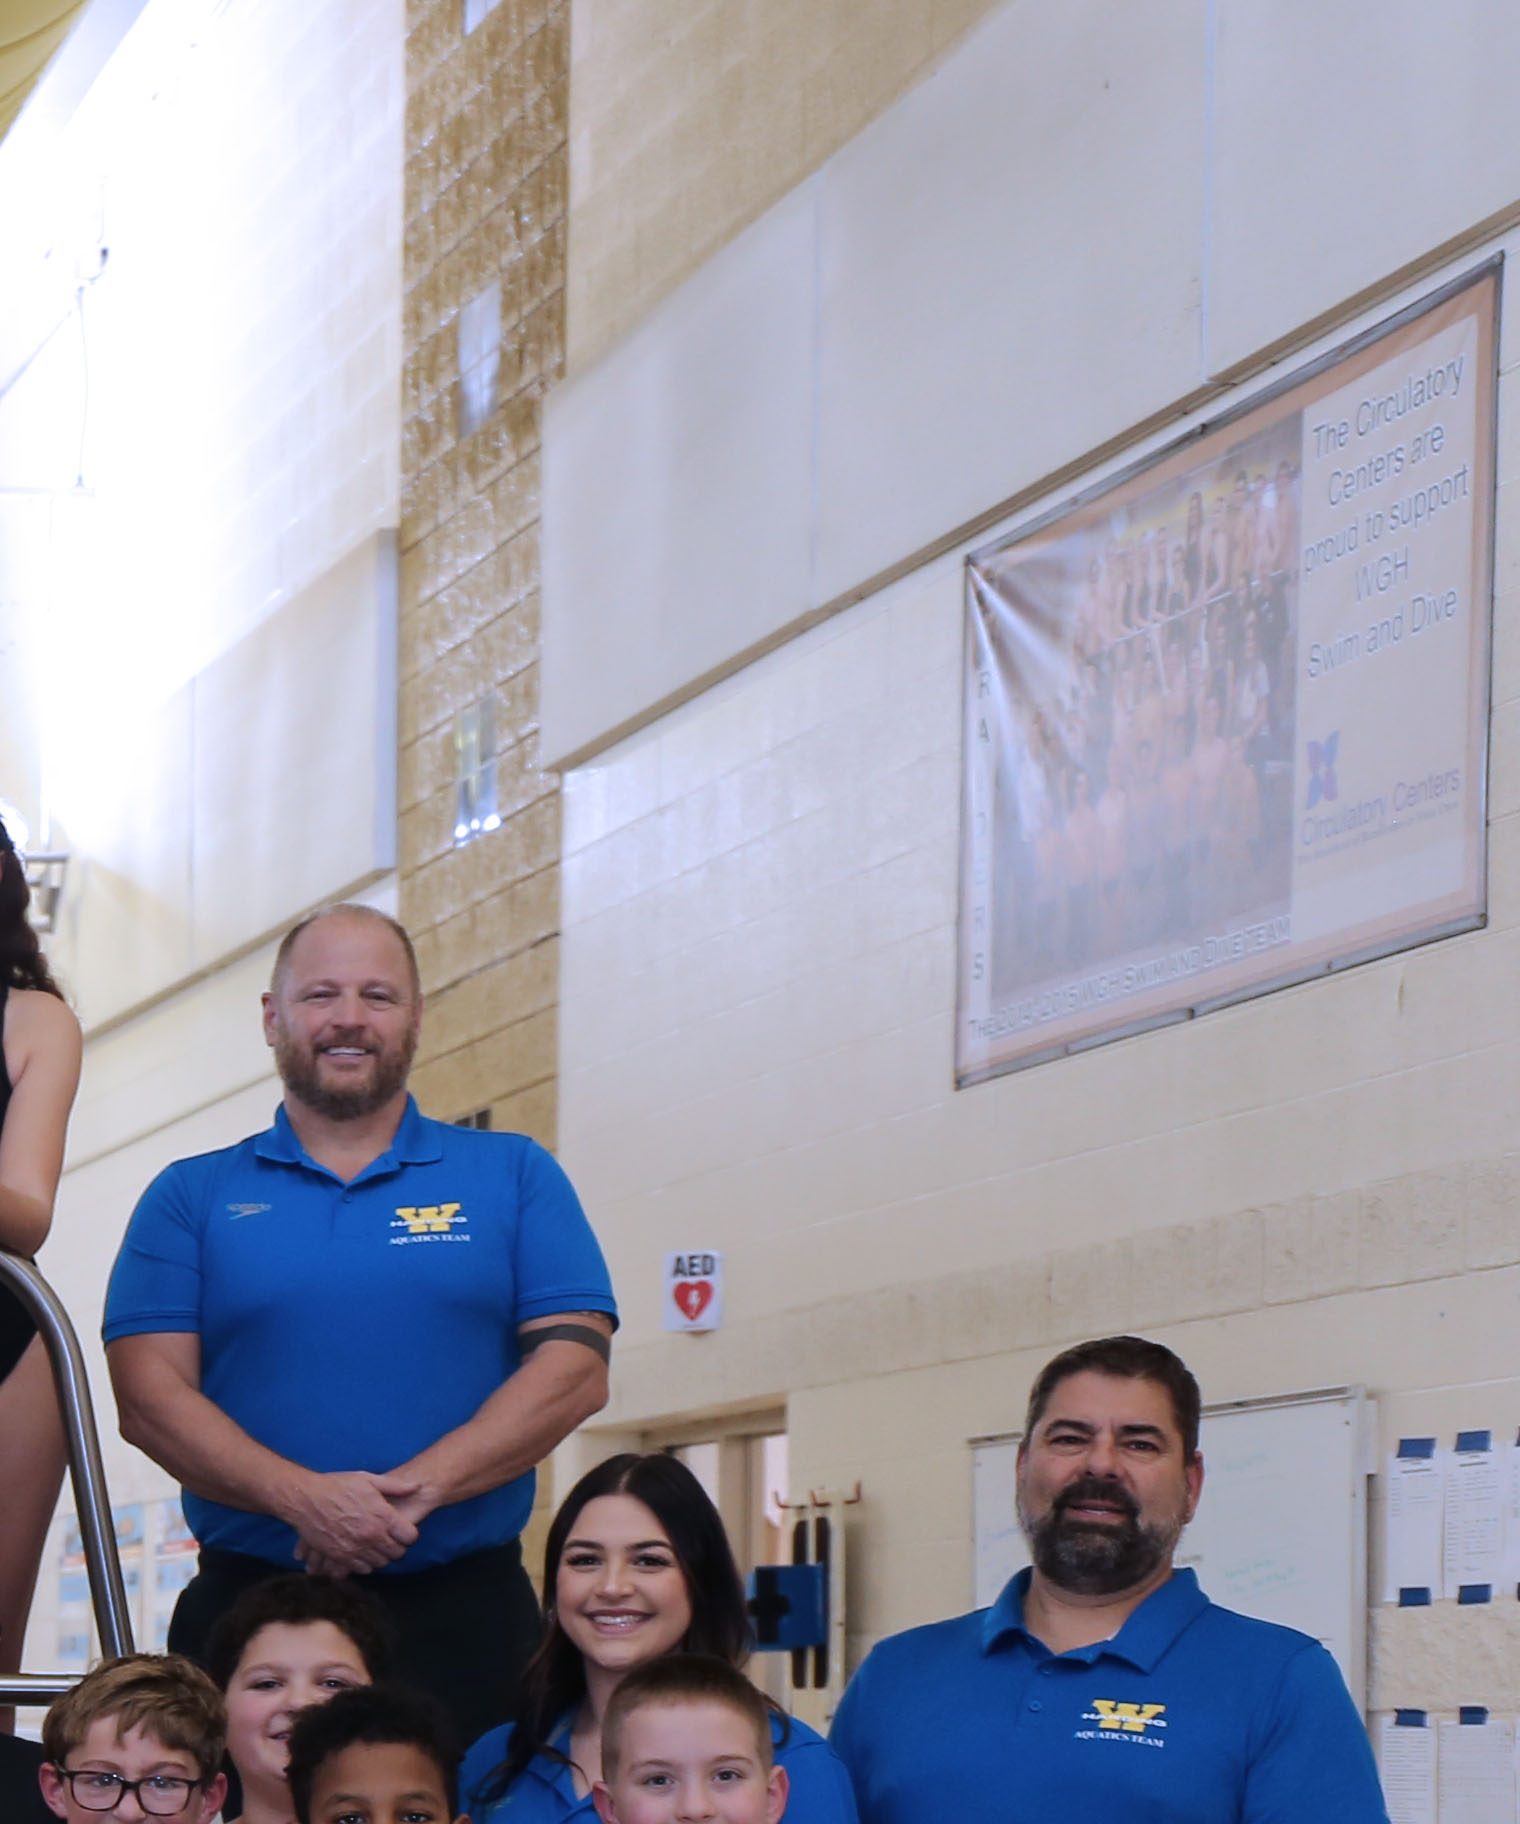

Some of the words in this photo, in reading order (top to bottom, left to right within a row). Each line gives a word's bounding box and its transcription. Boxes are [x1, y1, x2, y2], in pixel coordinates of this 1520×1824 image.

[1312, 420, 1349, 458] The
[1356, 355, 1464, 436] Circulatory
[1328, 446, 1405, 506] Centers
[1410, 424, 1445, 464] are
[1304, 516, 1358, 578] proud
[1365, 511, 1384, 543] to
[1389, 463, 1469, 530] support
[1355, 545, 1409, 601] WGH
[1306, 632, 1359, 678] Swim
[1366, 604, 1404, 653] and
[1411, 590, 1457, 633] Dive
[1393, 768, 1460, 812] Centers
[672, 1254, 715, 1278] AED
[1074, 1730, 1130, 1741] AQUATICS
[1131, 1734, 1165, 1748] TEAM
